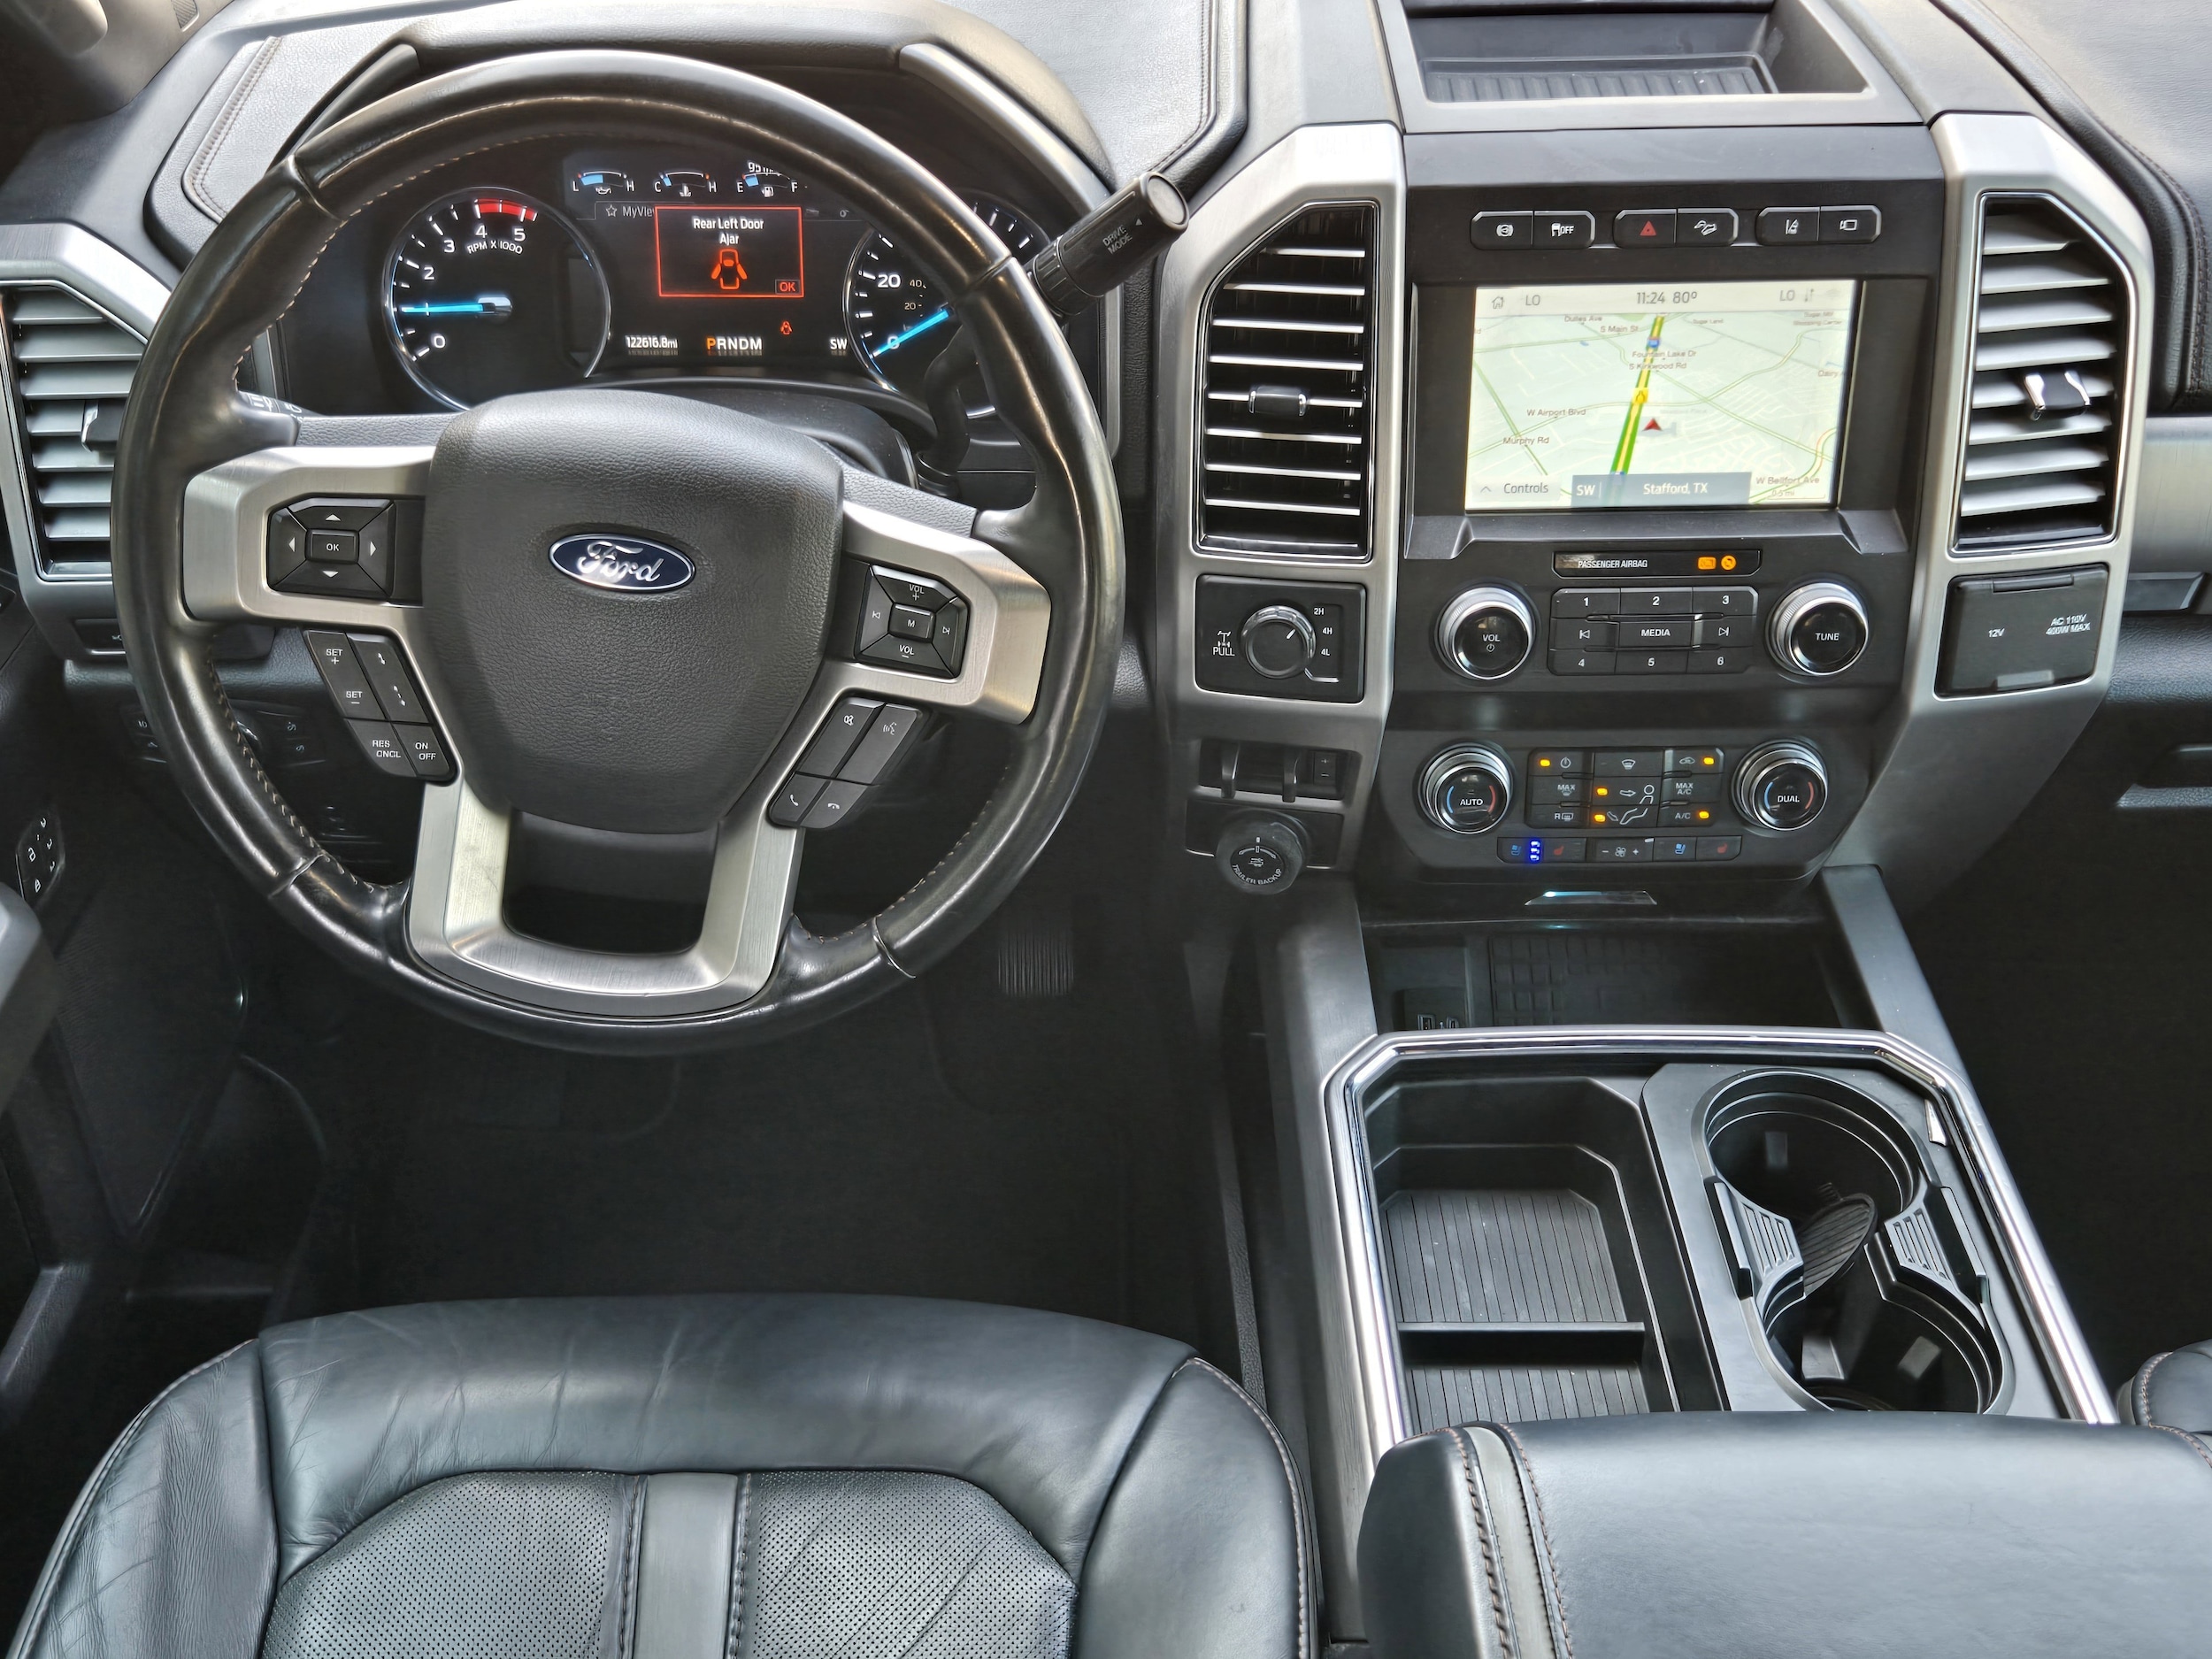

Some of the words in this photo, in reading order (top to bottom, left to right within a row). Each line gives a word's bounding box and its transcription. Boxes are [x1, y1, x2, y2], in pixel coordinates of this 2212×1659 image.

[572, 180, 580, 192] L
[626, 180, 635, 192] H
[655, 180, 662, 193] C
[709, 180, 718, 193] H
[737, 180, 744, 193] E
[791, 180, 798, 193] F
[622, 205, 655, 219] MyVie
[693, 218, 717, 229] Rear
[718, 218, 739, 229] Left
[740, 218, 764, 229] Door
[475, 225, 488, 239] 4
[513, 227, 526, 242] 5
[1560, 225, 1575, 234] OFF
[719, 233, 740, 246] Ajar
[1102, 225, 1127, 247] DRIVE
[443, 239, 456, 253] 3
[466, 241, 488, 255] RPM
[490, 240, 497, 250] X
[500, 241, 523, 255] 1000
[1108, 233, 1133, 255] MODE
[424, 266, 435, 280] 2
[877, 273, 902, 288] 20
[780, 281, 796, 292] OK
[1525, 295, 1540, 306] LO
[1636, 291, 1666, 304] 11:24
[1779, 289, 1796, 302] LO
[904, 302, 917, 311] 20
[434, 335, 446, 349] 0
[829, 338, 848, 350] SW
[1538, 409, 1566, 418] Airport
[1502, 437, 1535, 446] Murphy
[1503, 482, 1549, 494] Controls
[1576, 484, 1596, 496] SW
[1643, 482, 1691, 495] Stafford,
[1693, 482, 1709, 494] TX
[326, 542, 340, 551] OK
[577, 541, 664, 582] Ford
[1578, 559, 1620, 568] PASSENGER
[1621, 559, 1648, 568] AIRBAG
[909, 584, 925, 595] VOL
[1583, 597, 1589, 607] 1
[1652, 595, 1660, 606] 2
[1722, 595, 1730, 605] 3
[1313, 607, 1325, 616] 2H
[907, 618, 916, 627] M
[2050, 617, 2065, 626] AC
[1322, 626, 1333, 635] 4H
[1640, 628, 1671, 637] MEDIA
[1988, 627, 2006, 638] 12V
[1482, 634, 1501, 642] VOL
[1815, 632, 1840, 641] TUNE
[899, 644, 915, 656] VOL
[1212, 646, 1235, 657] PULL
[1578, 657, 1586, 667] 4
[1647, 657, 1655, 667] 5
[1717, 657, 1724, 665] 6
[346, 690, 363, 699] SET
[372, 739, 391, 749] RES
[414, 741, 429, 750] ON
[419, 752, 436, 761] OFF
[1777, 795, 1801, 803] DUAL
[1674, 811, 1691, 820] A/C
[1232, 864, 1256, 885] TRAILER
[1256, 868, 1282, 885] BACKUP
